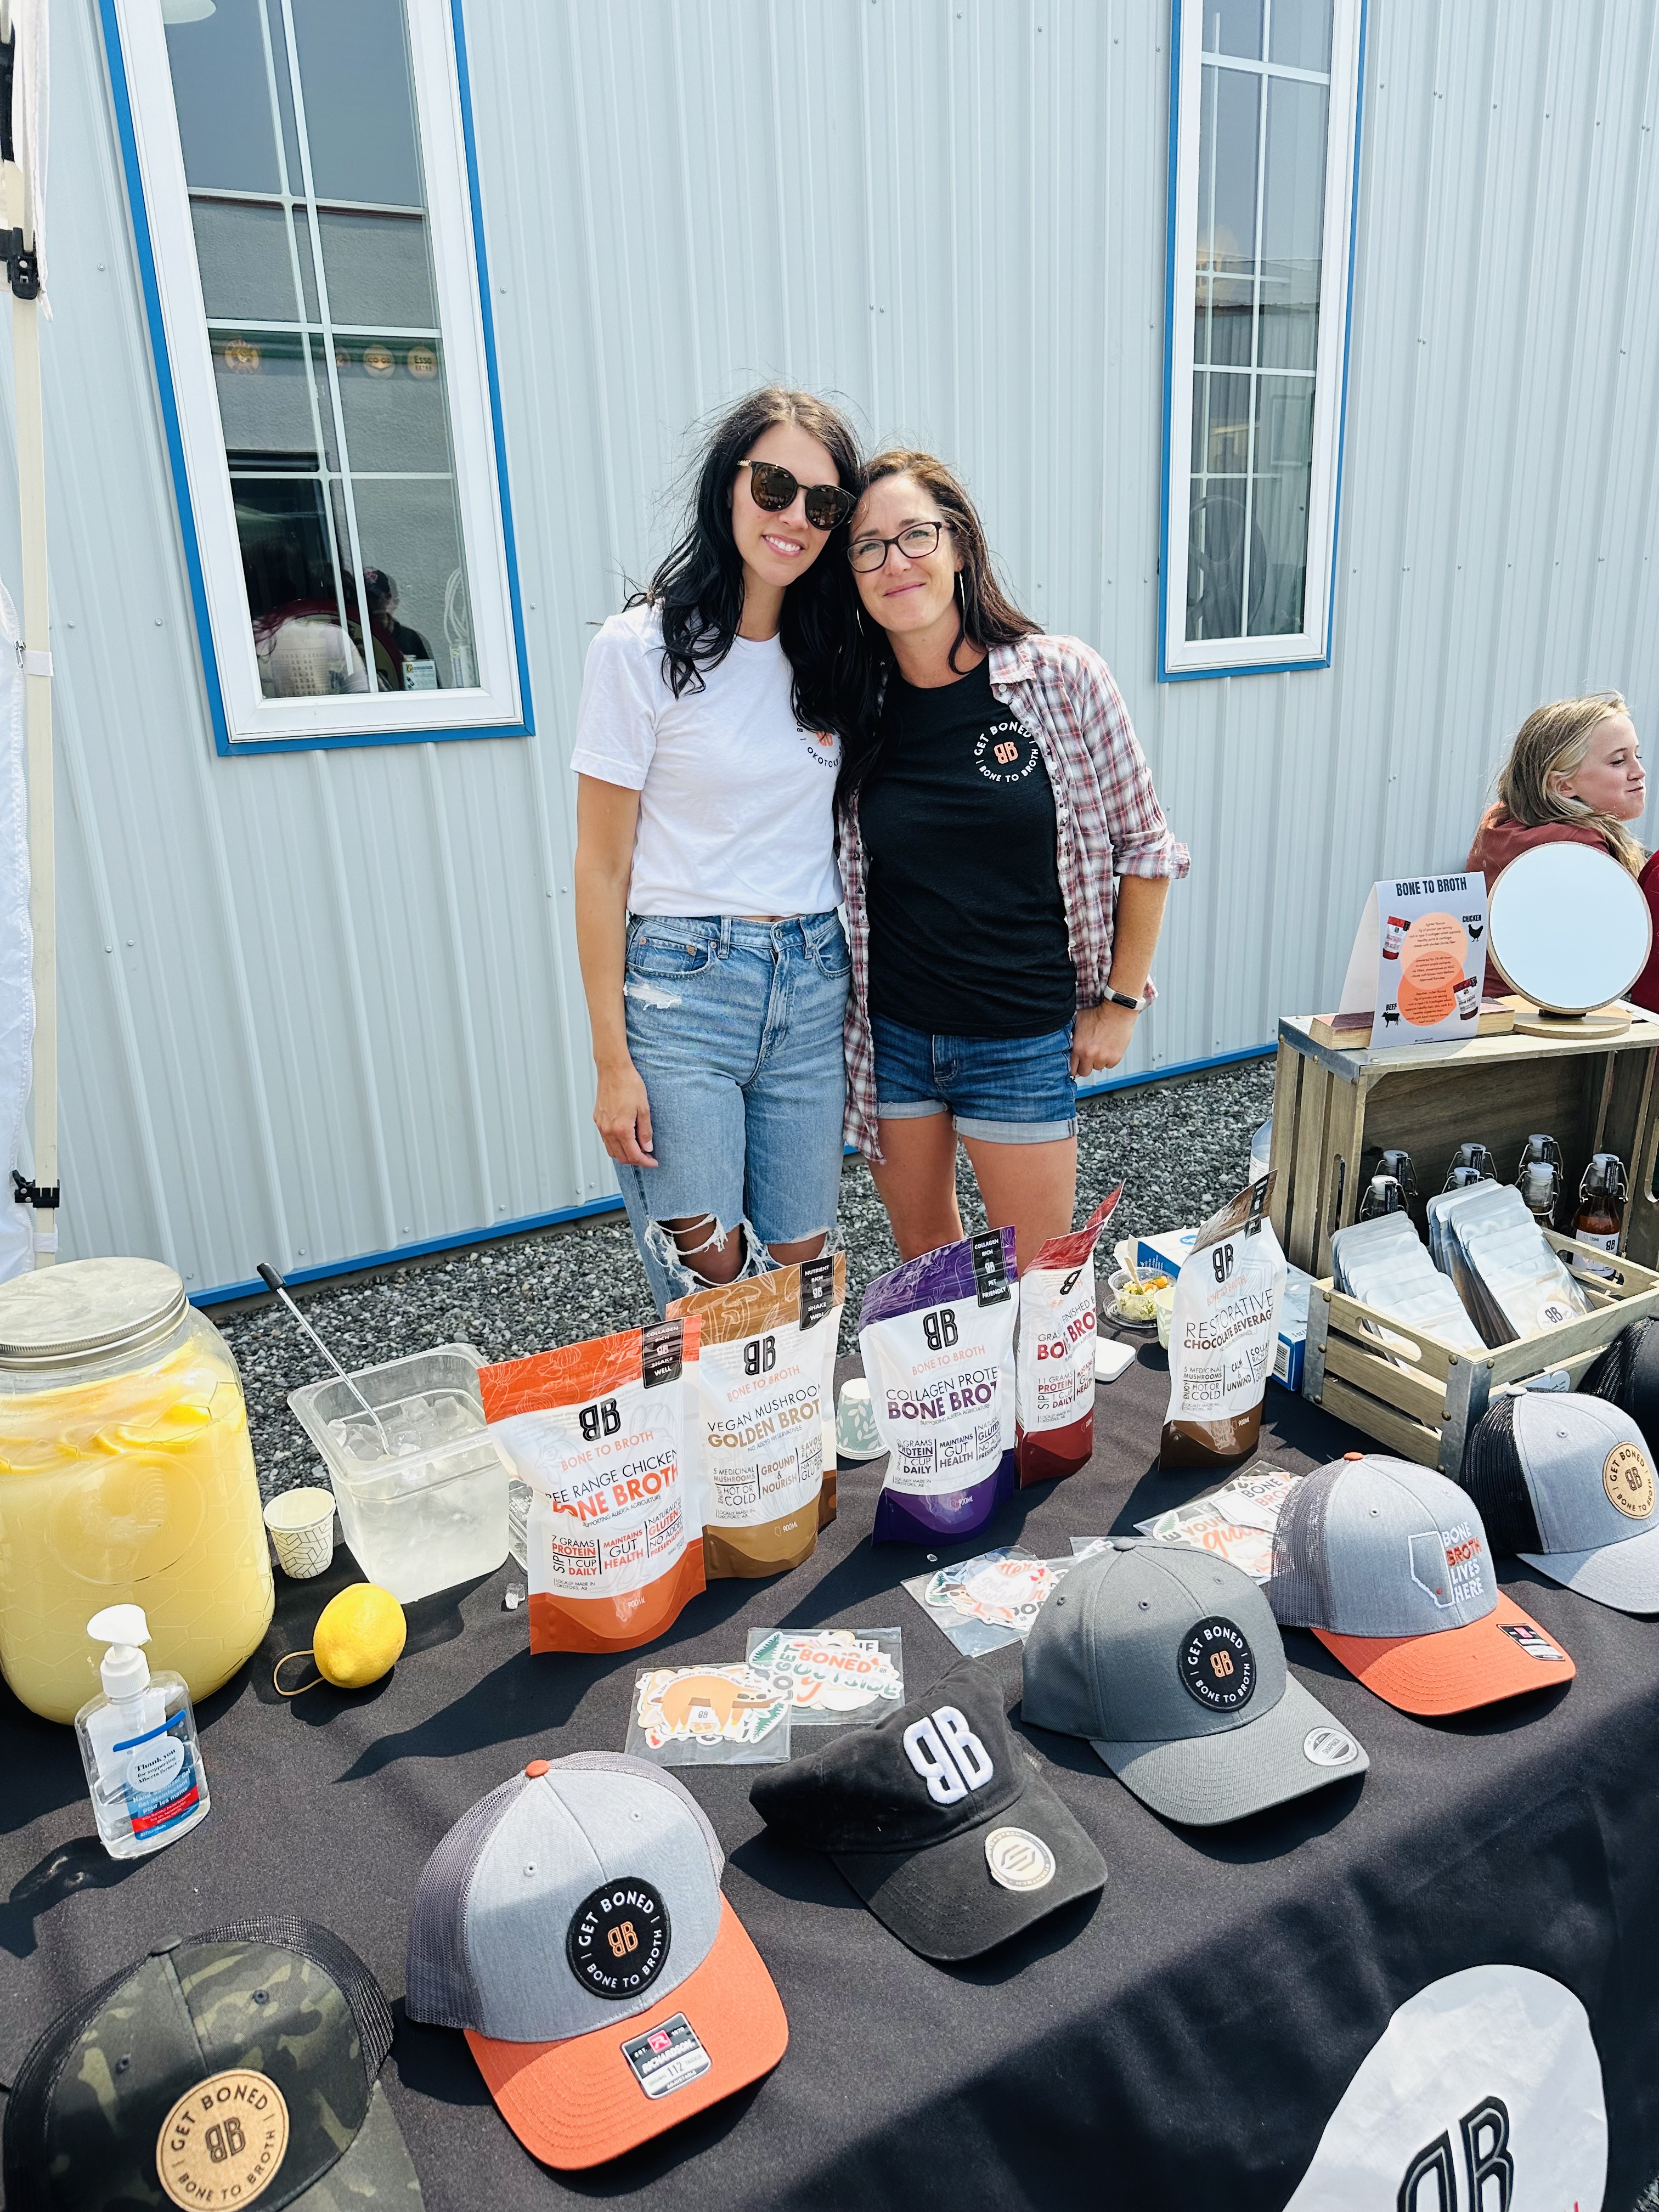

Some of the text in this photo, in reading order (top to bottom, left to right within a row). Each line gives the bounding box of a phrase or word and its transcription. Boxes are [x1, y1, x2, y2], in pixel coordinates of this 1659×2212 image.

[974, 721, 1032, 757] GET BONED
[808, 747, 839, 768] OKOTOKS
[979, 748, 1039, 782] BONE TO BROTH
[1396, 877, 1467, 896] BONE TO BROTH
[1462, 914, 1482, 923] CHICKEN
[974, 1238, 998, 1250] COLLAGEN
[804, 1265, 830, 1276] NUTRIENT
[988, 1278, 996, 1286] PET
[1206, 1275, 1246, 1306] BONE BROTH
[982, 1286, 1006, 1299] FRIENDLY
[808, 1301, 827, 1312] SHAKE
[1186, 1288, 1273, 1339] RESTORATIVE
[646, 1326, 679, 1338] COLLAGEN
[1184, 1327, 1233, 1350] CHOCOLATE
[651, 1357, 673, 1368] SHAKE
[912, 1345, 985, 1376] BONE TO BROTH
[1232, 1358, 1243, 1372] CALM
[654, 1365, 672, 1376] WELL
[1049, 1371, 1073, 1383] GRAMS
[1080, 1368, 1091, 1385] GUT
[727, 1364, 800, 1402] BONE TO BROTH
[887, 1378, 955, 1401] COLLAGEN
[1039, 1378, 1073, 1392] PROTEIN
[1076, 1375, 1093, 1396] HEALTH
[1227, 1374, 1251, 1392] UNWIND
[1037, 1395, 1049, 1409] SIP
[1053, 1396, 1073, 1408] DAILY
[1059, 1388, 1073, 1399] CUP
[1192, 1391, 1221, 1400] COLD
[887, 1397, 946, 1419] BONE
[708, 1411, 752, 1432] VEGAN
[708, 1398, 820, 1448] GOLDEN BROT
[757, 1425, 803, 1449] ADDED PRESERVATIVES
[939, 1434, 973, 1448] MAINTAINS
[561, 1430, 654, 1471] BONE TO BROTH
[897, 1442, 933, 1456] PROTEIN
[944, 1442, 969, 1457] GUT
[761, 1454, 795, 1476] GROUND
[911, 1458, 931, 1466] CUP
[940, 1451, 973, 1468] HEALTH
[1610, 1449, 1645, 1481] GET BONED
[714, 1472, 756, 1483] MUSHROOMS
[719, 1466, 755, 1475] MEDICINAL
[904, 1465, 932, 1474] DAILY
[572, 1470, 619, 1498] RANGE
[612, 1463, 678, 1507] BROTH
[724, 1485, 753, 1496] HOT OR
[762, 1472, 798, 1495] NOURISH
[1241, 1477, 1283, 1498] BONE
[612, 1494, 662, 1519] ALBERTA AGRICULTURE
[725, 1493, 756, 1506] COLD
[1617, 1494, 1636, 1511] BONE
[649, 1509, 679, 1536] GLUTEN
[560, 1537, 595, 1548] GRAMS
[603, 1529, 643, 1548] MAINTAINS
[650, 1536, 663, 1549] NO
[1441, 1521, 1472, 1548] BONE
[552, 1543, 596, 1556] PROTEIN
[610, 1538, 637, 1557] GUT
[1446, 1537, 1482, 1566] BROTH
[553, 1555, 565, 1573] SIP
[576, 1559, 596, 1567] CUP
[605, 1548, 644, 1569] HEALTH
[569, 1567, 597, 1576] DAILY
[1449, 1558, 1480, 1585] LIVES
[1454, 1577, 1484, 1603] HERE
[628, 1596, 646, 1609] 900ML
[1188, 1626, 1243, 1665] GET BONED
[775, 1644, 900, 1696] GET BONED OUTSIDE
[730, 1678, 742, 1686] BONE
[1195, 1663, 1250, 1702] BONE TO BROTH
[136, 1749, 176, 1771] Thank you
[148, 1757, 177, 1774] supporting
[133, 1768, 191, 1803] Hand Gel
[143, 1803, 158, 1814] pour
[170, 1786, 188, 1801] mains
[578, 1891, 654, 1946] GET BONED
[586, 1929, 662, 1988] BONE TO BROTH
[667, 2061, 685, 2076] 112
[171, 2084, 268, 2151] GET BONED
[178, 2129, 275, 2201] BONE TO BROTH
